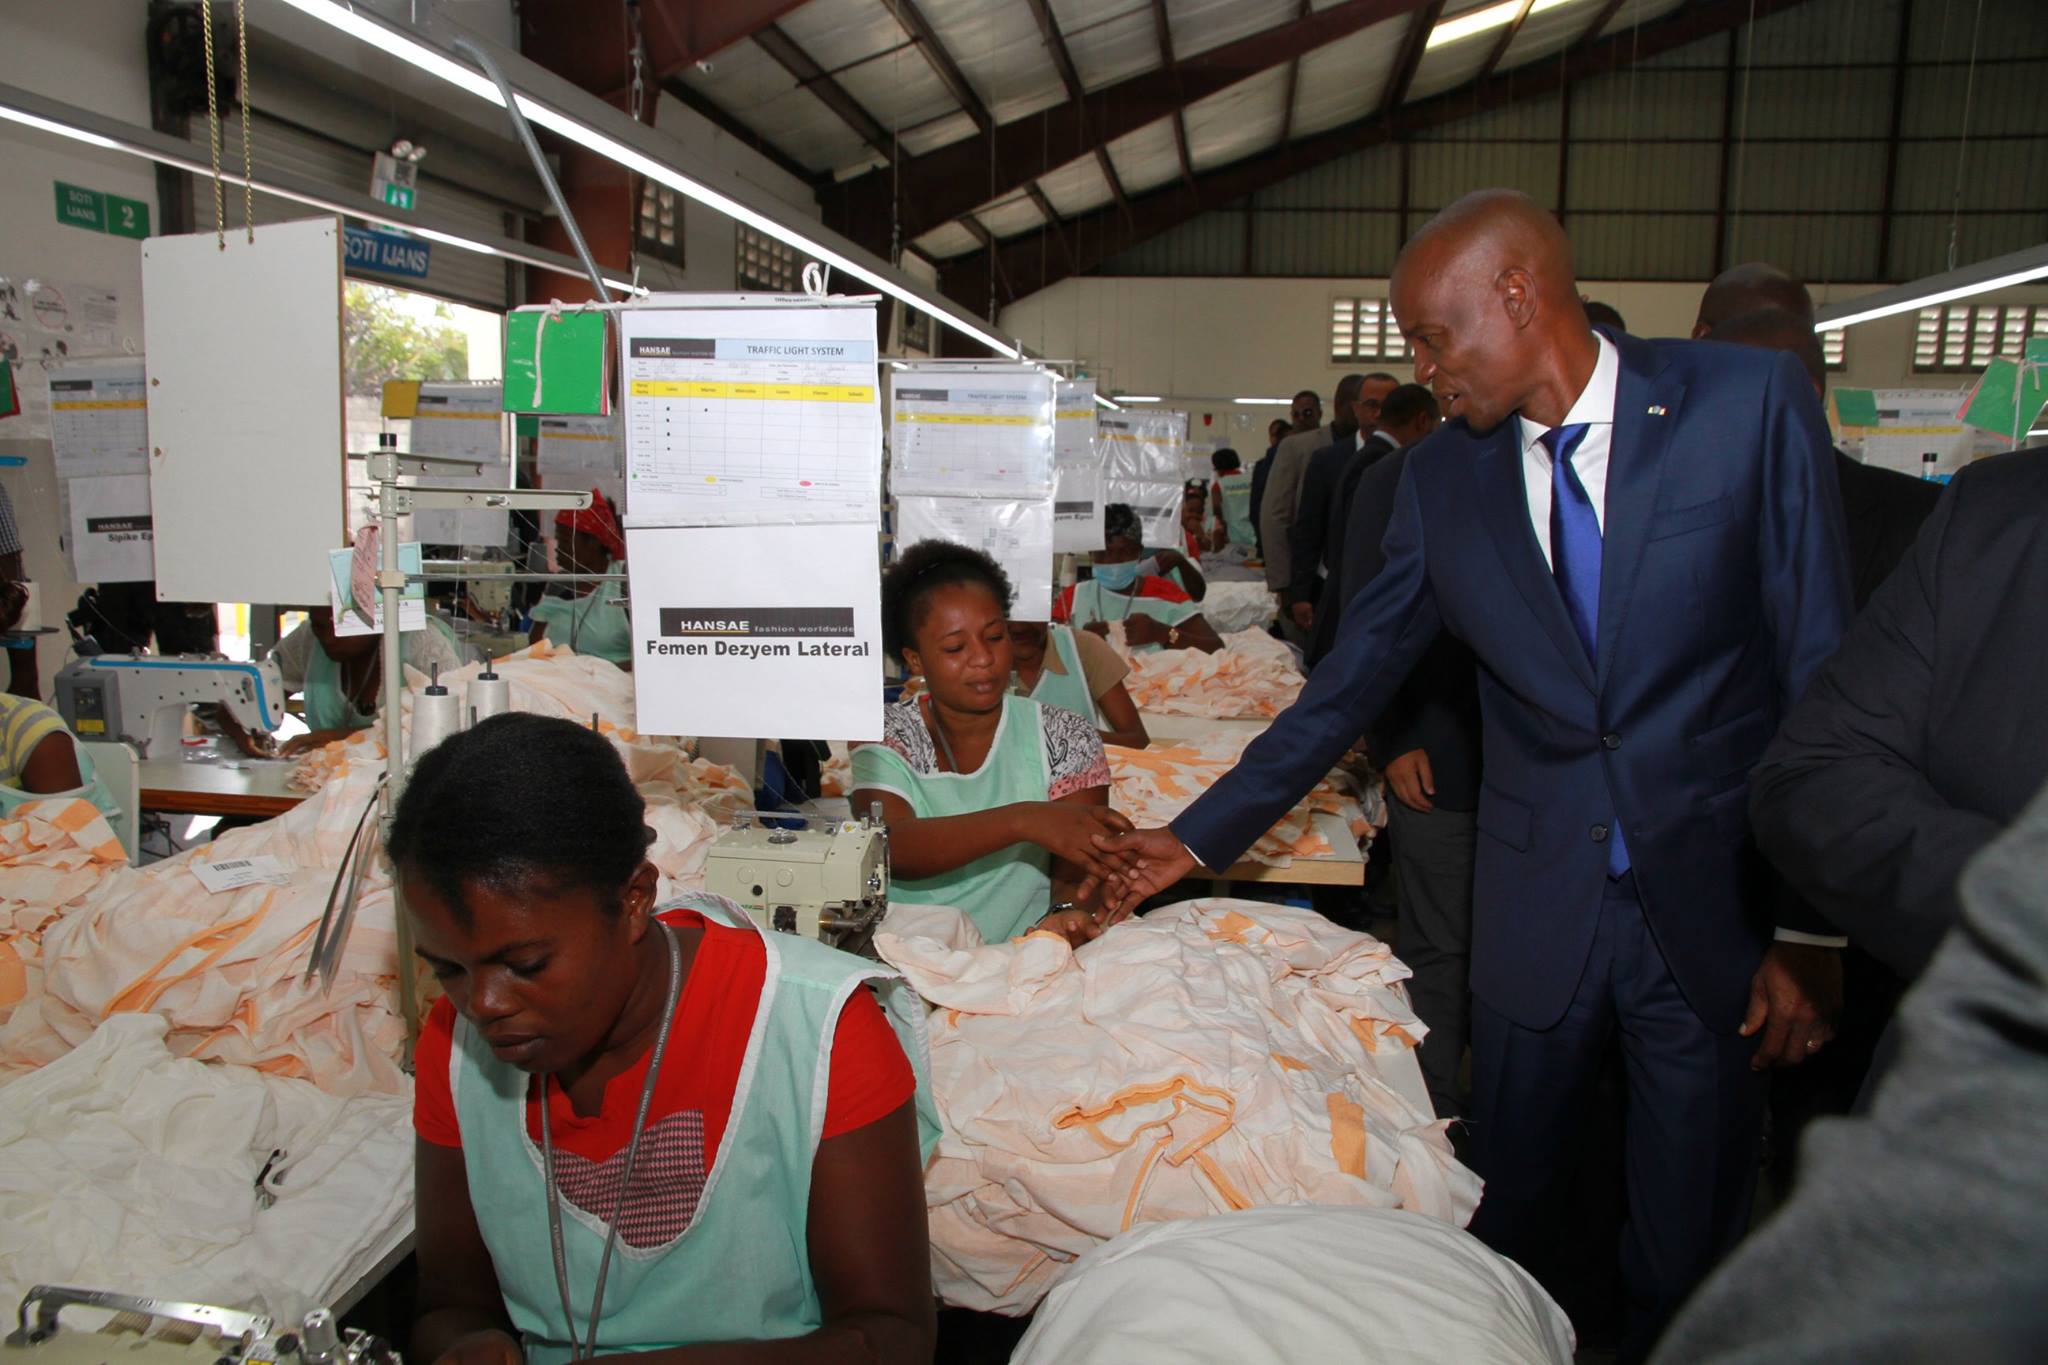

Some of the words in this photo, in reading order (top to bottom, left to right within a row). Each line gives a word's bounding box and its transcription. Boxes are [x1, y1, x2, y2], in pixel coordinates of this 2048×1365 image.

[69, 190, 93, 206] SOTI
[121, 205, 135, 229] 2
[382, 243, 427, 273] IJANS
[639, 345, 671, 353] HANSAE
[747, 345, 781, 354] TRAFFIC
[783, 346, 809, 356] LIGHT
[811, 347, 844, 356] SYSTEM
[680, 620, 750, 631] HANSAE
[754, 625, 795, 633] fashion
[798, 625, 854, 633] worldwide
[647, 640, 708, 656] Femen
[714, 641, 791, 659] Dezyem
[797, 641, 869, 656] Lateral
